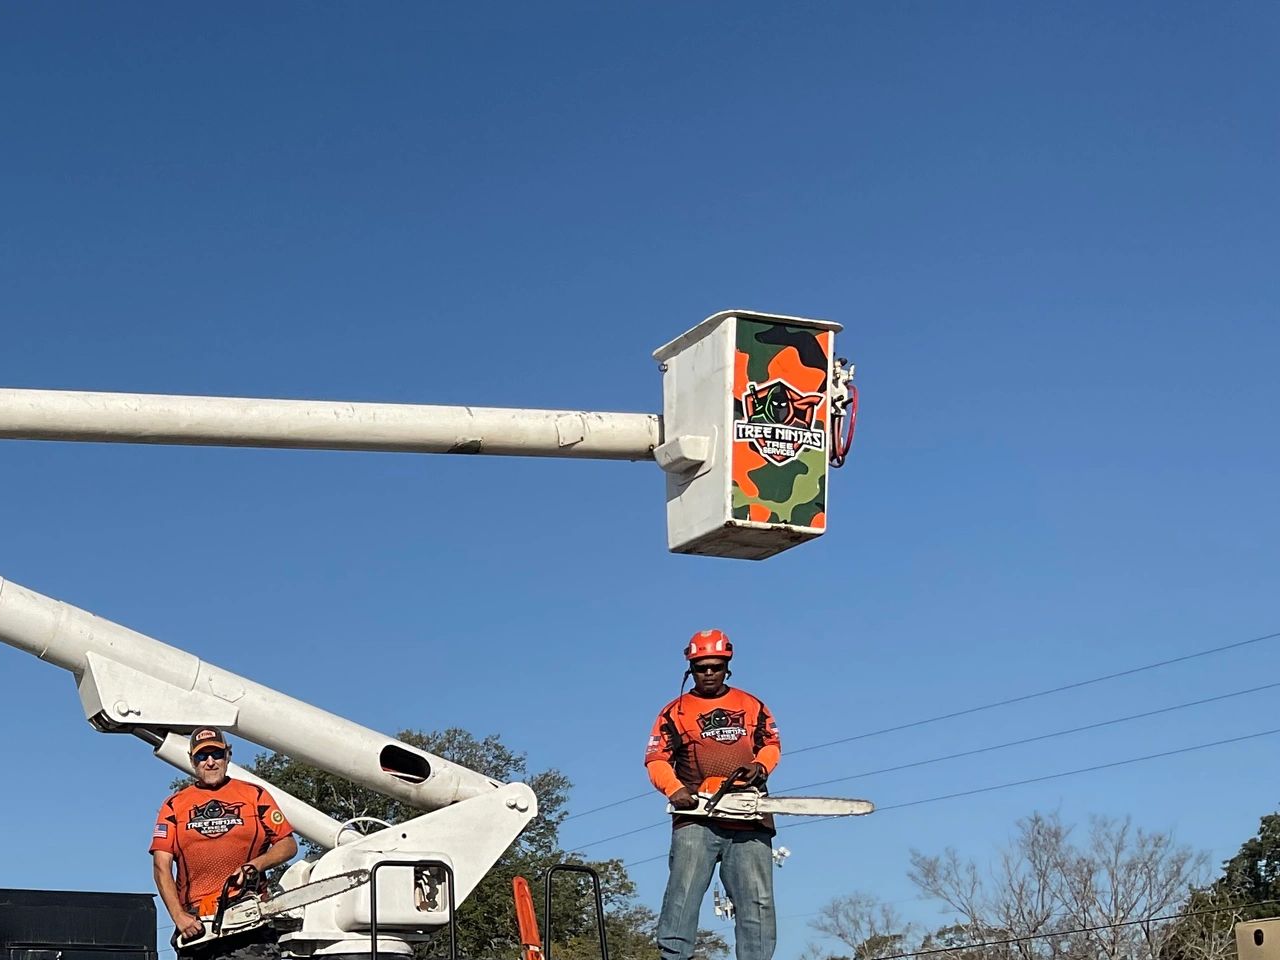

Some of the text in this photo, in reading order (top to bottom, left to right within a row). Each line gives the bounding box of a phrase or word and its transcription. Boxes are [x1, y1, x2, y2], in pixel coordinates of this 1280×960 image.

[738, 425, 821, 446] TREE NINJAS
[765, 441, 793, 449] TREE
[763, 447, 795, 456] SERVICES
